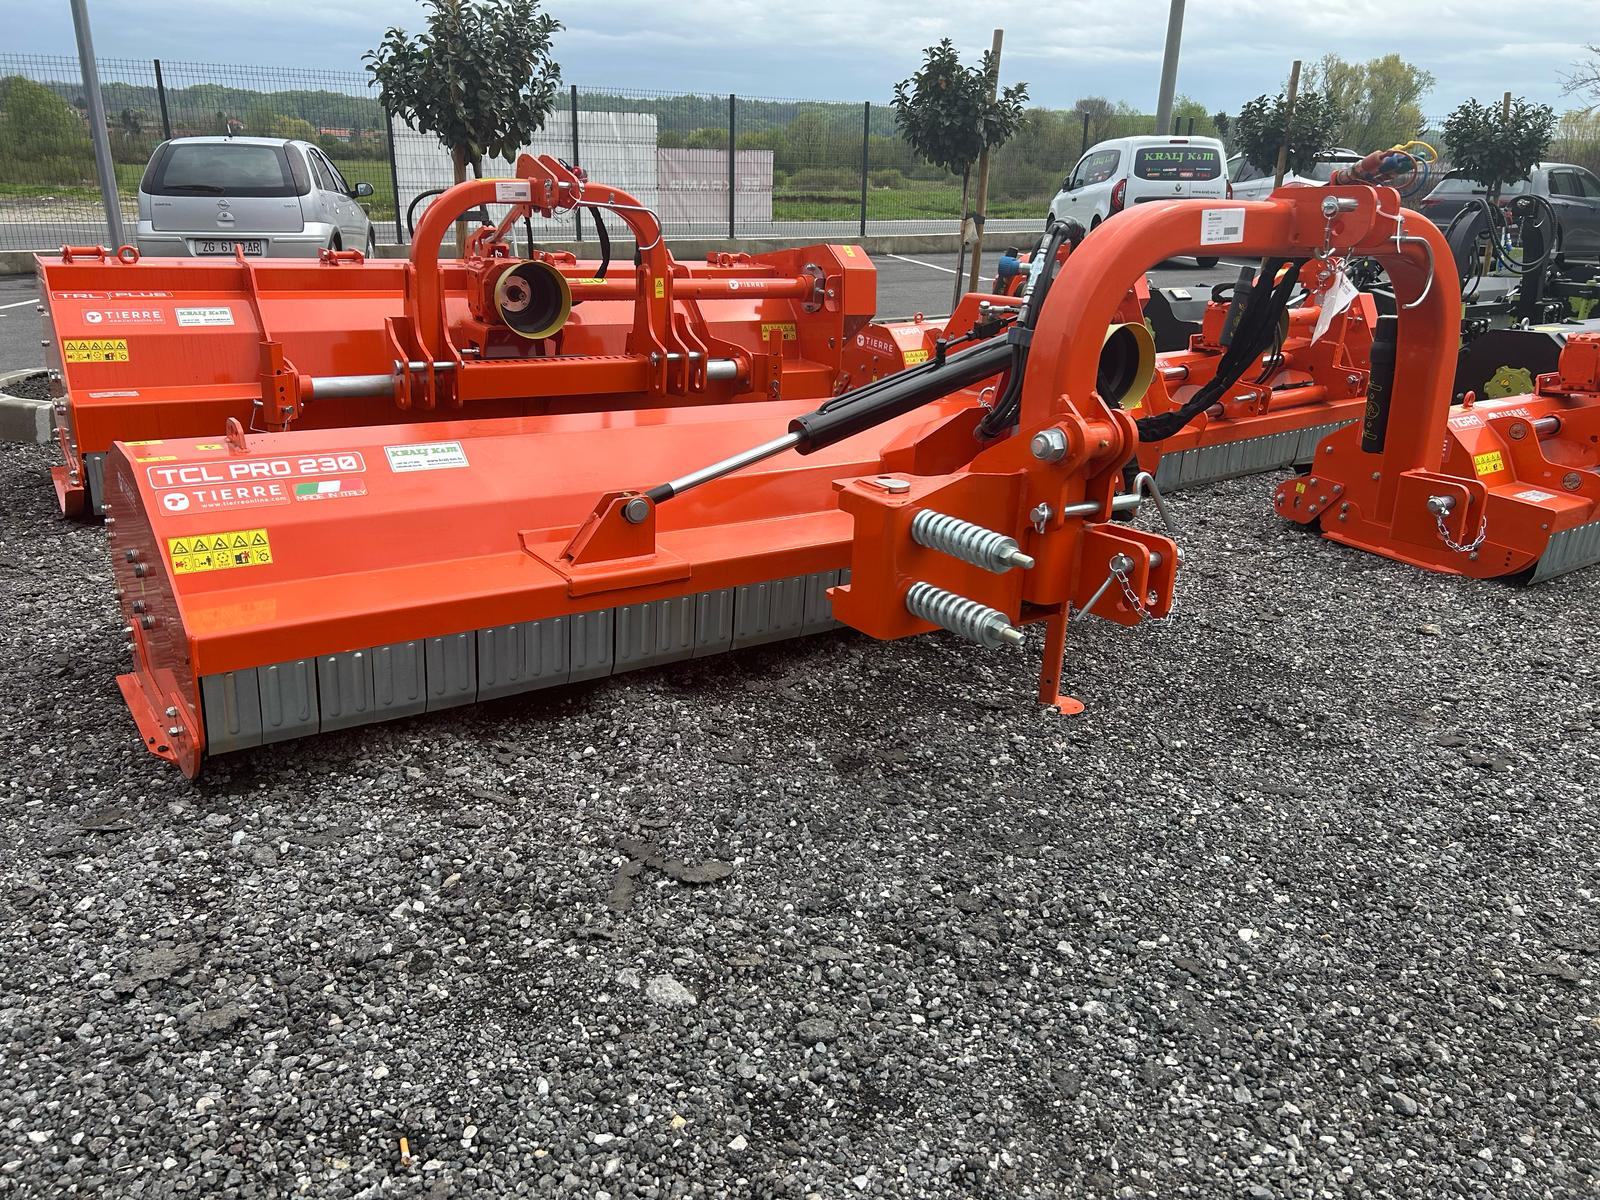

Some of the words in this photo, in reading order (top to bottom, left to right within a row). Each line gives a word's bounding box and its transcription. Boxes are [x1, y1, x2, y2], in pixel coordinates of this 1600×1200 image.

[1145, 152, 1184, 163] KRALJ
[203, 242, 215, 252] ZG
[105, 311, 161, 319] TIERRE
[866, 336, 894, 353] TIERRE
[391, 448, 428, 457] KRALJ
[157, 468, 223, 484] TCL
[229, 461, 291, 479] PRO
[299, 455, 358, 473] 230
[193, 484, 282, 502] TIERRE
[297, 493, 326, 502] MADE
